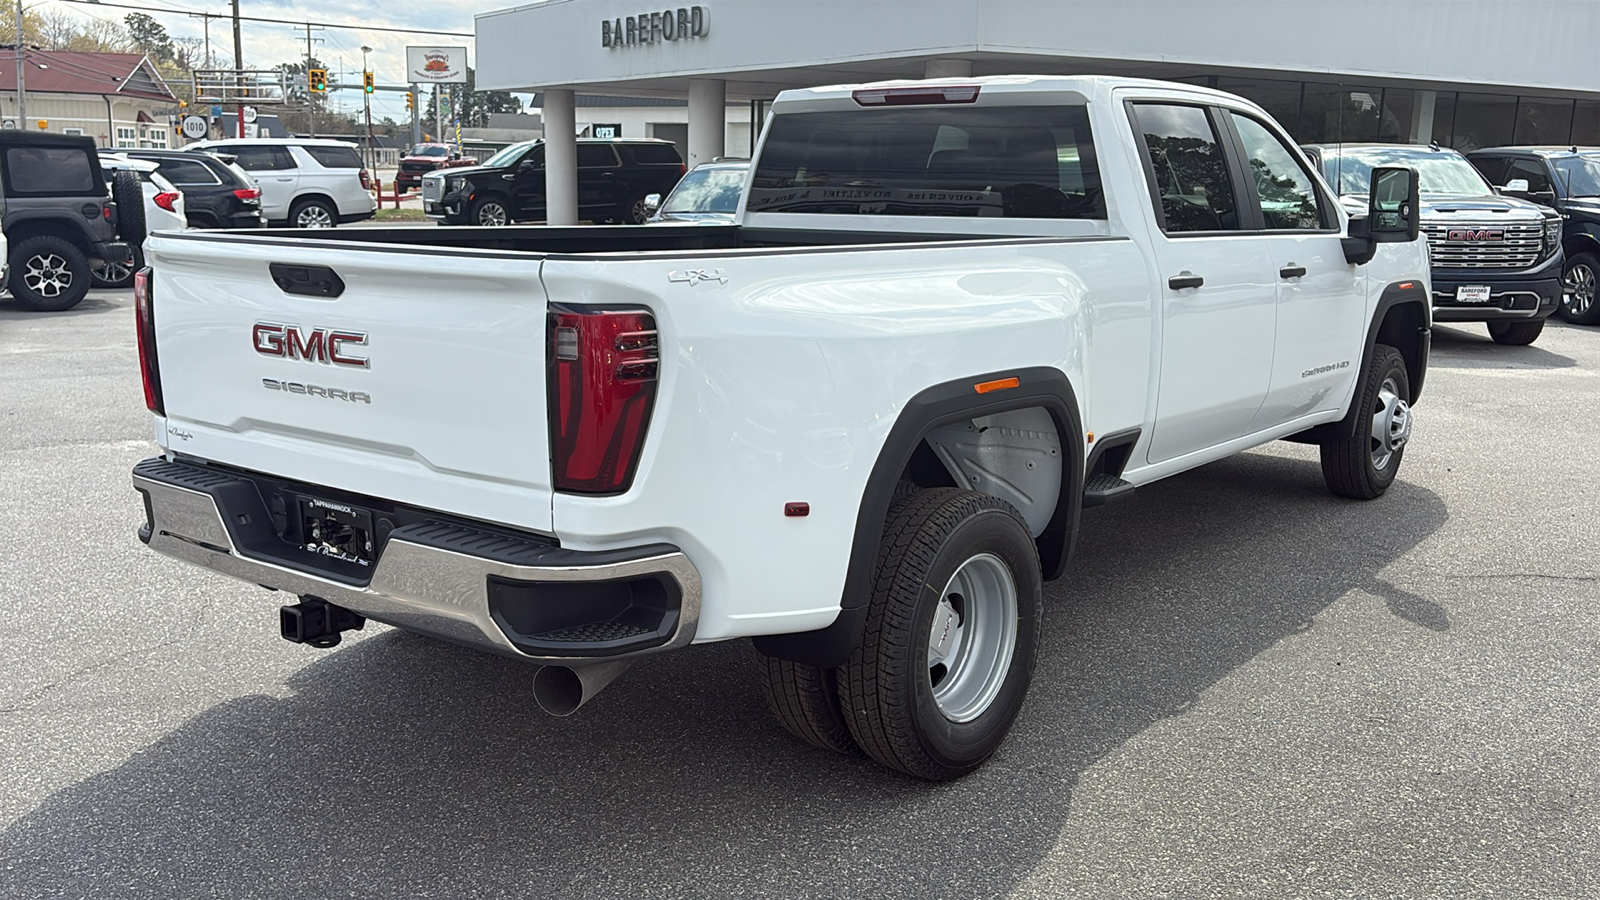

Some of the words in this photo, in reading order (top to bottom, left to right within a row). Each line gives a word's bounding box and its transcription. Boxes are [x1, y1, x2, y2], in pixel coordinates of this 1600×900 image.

[602, 6, 710, 48] BAREFORD
[186, 122, 204, 132] 1010
[595, 127, 615, 138] OPEN
[1449, 230, 1503, 241] GMC
[252, 319, 371, 370] GMC
[262, 378, 371, 404] SIERRA
[313, 499, 352, 514] TAPPAHANNOCK
